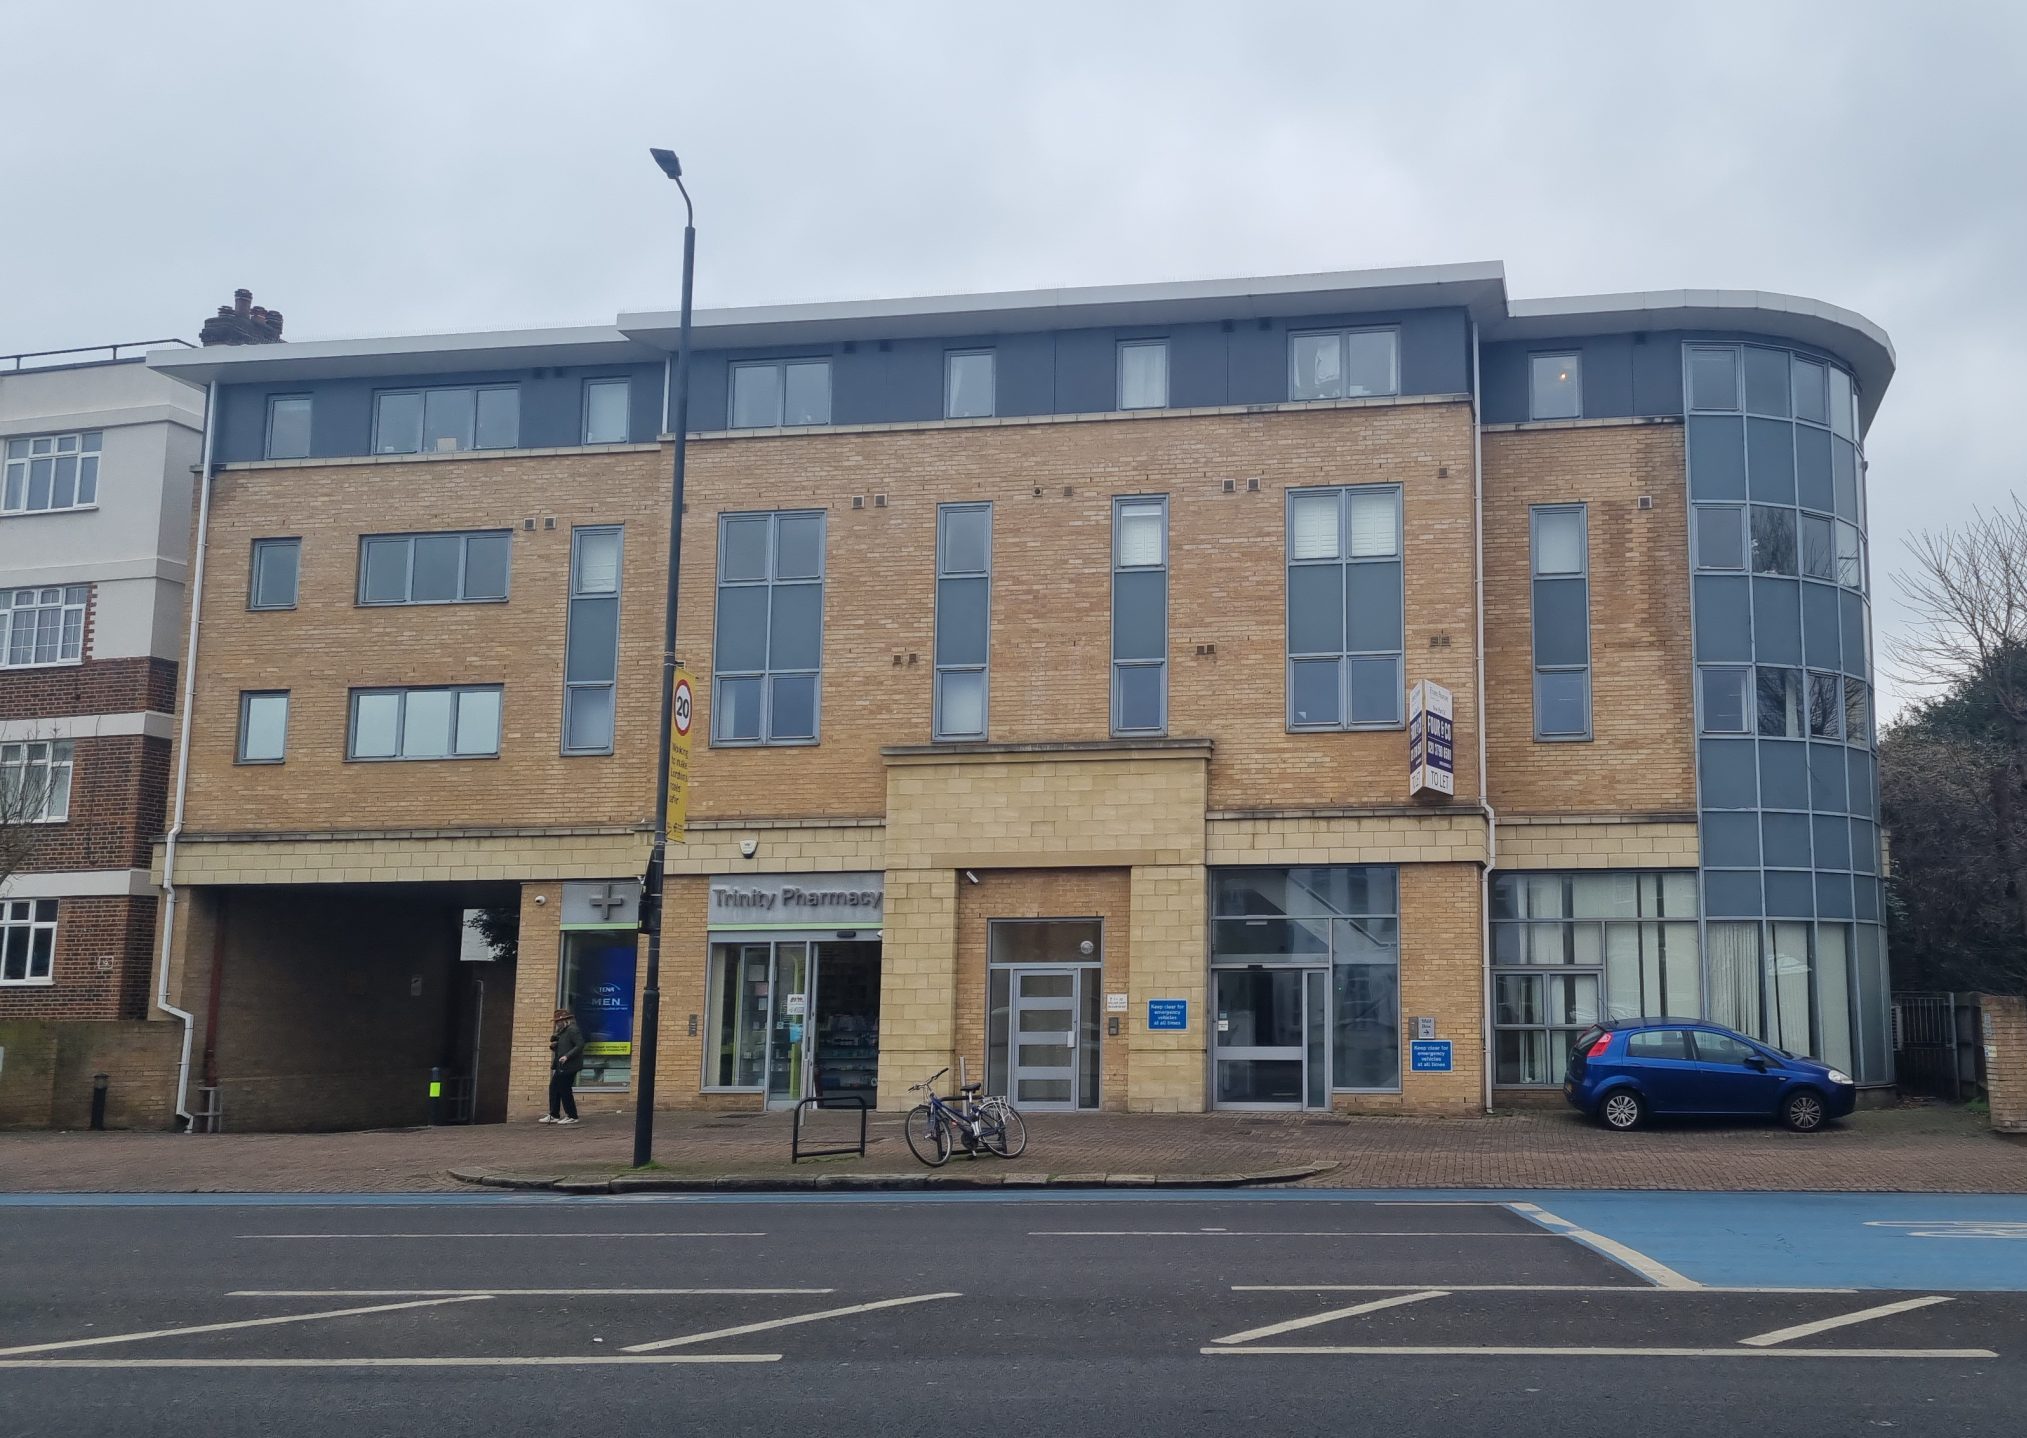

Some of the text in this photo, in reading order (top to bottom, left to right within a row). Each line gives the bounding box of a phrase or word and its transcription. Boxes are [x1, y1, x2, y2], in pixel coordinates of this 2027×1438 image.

[676, 696, 690, 719] 20
[1431, 770, 1439, 787] TO
[1439, 773, 1449, 790] LET
[713, 887, 883, 911] Trinity Pharmacy
[591, 998, 621, 1006] MEN
